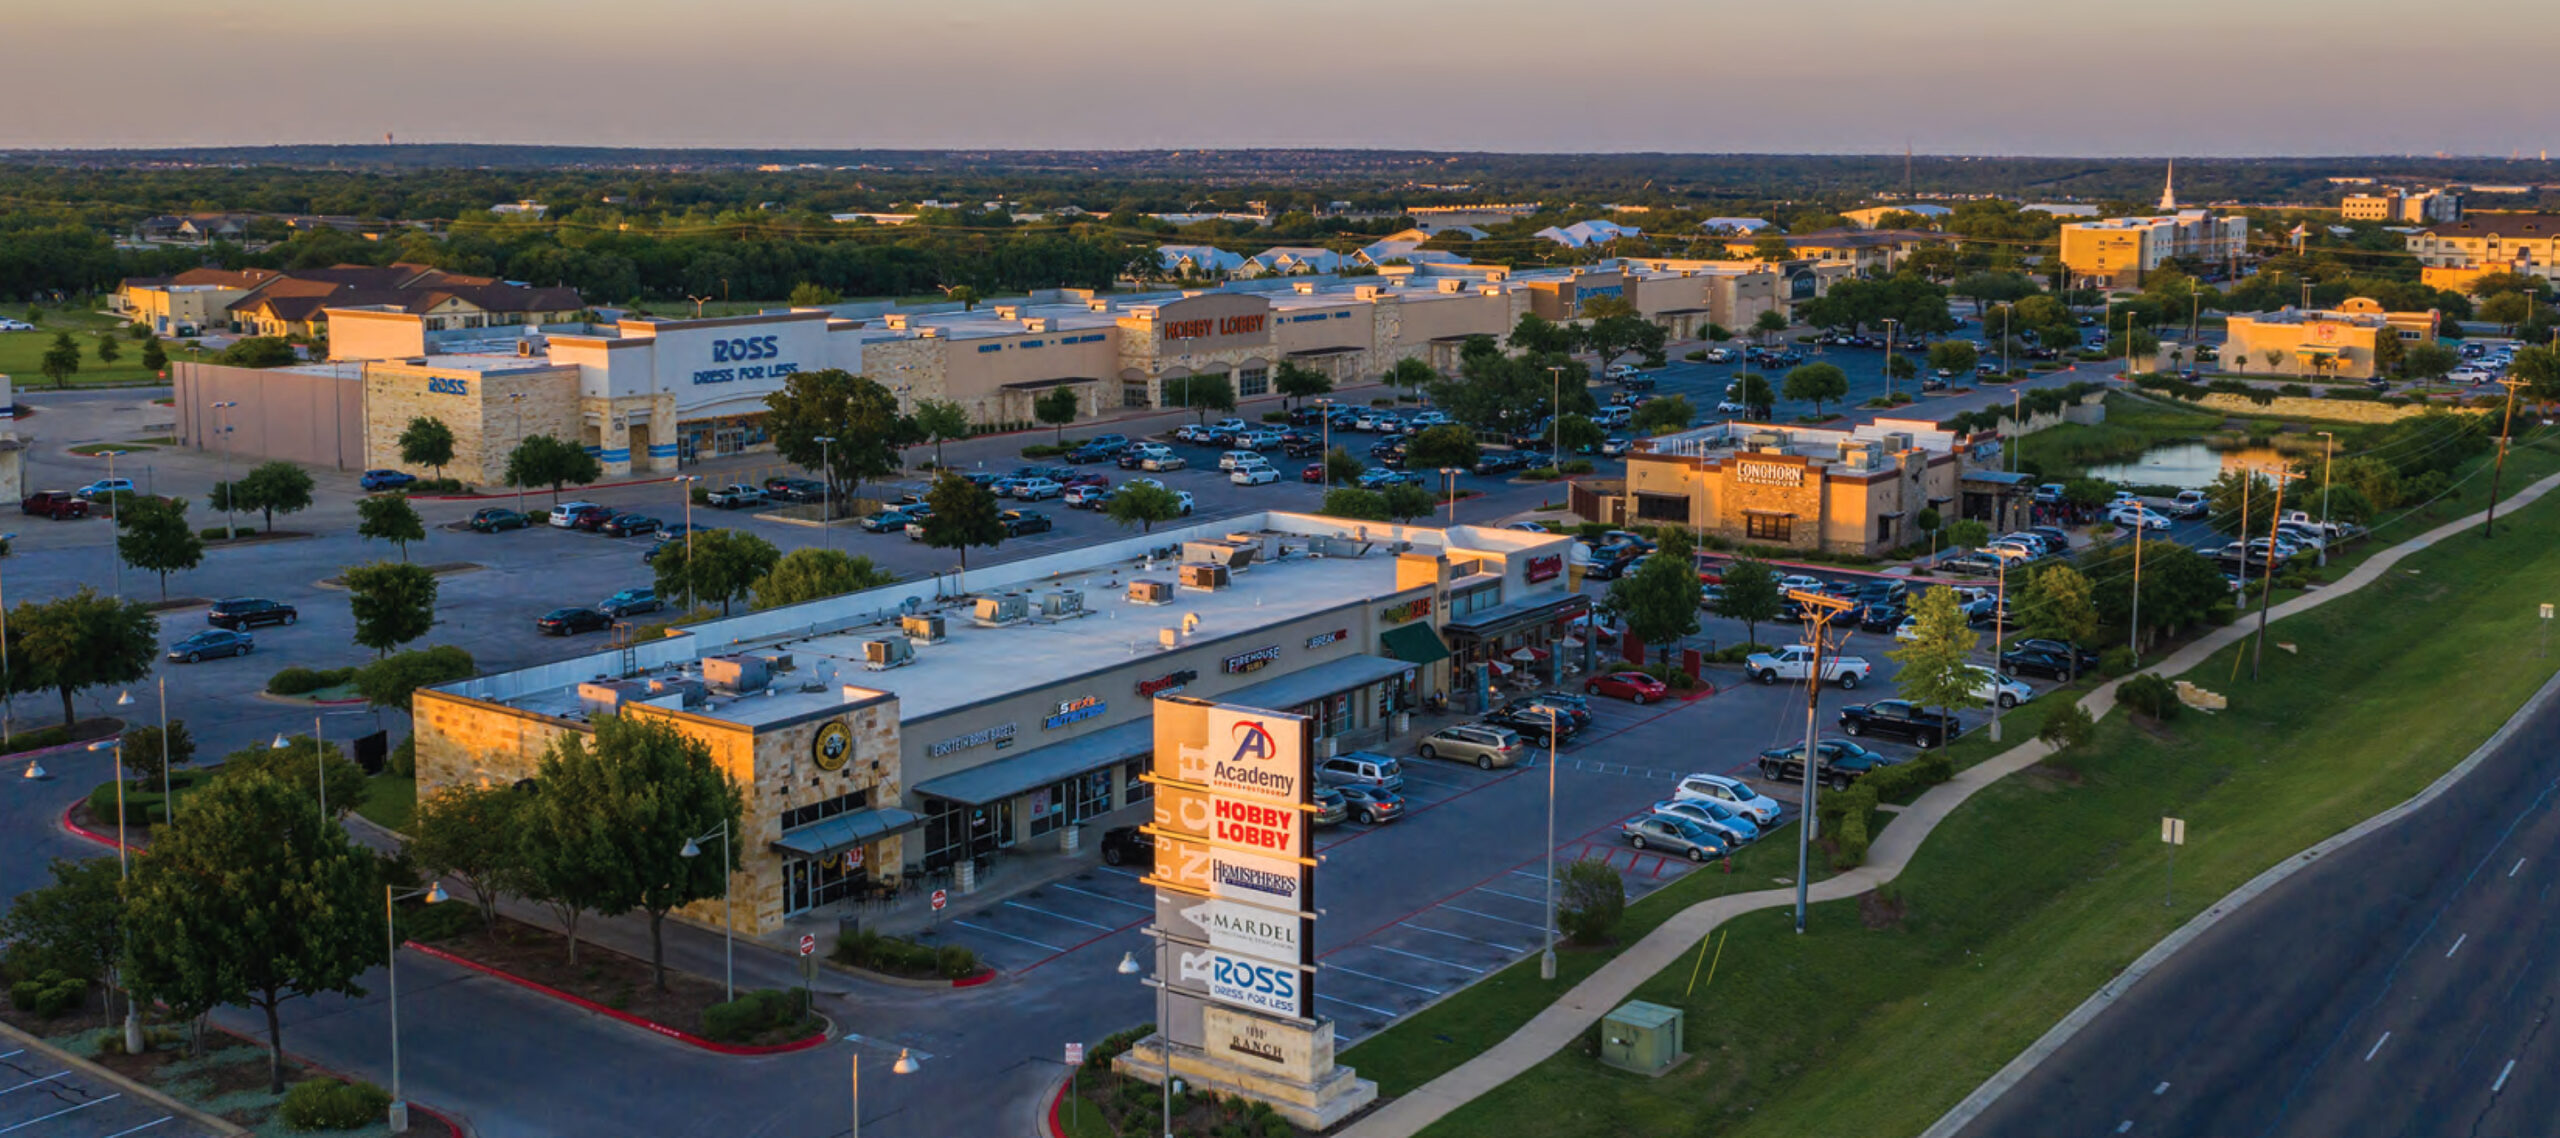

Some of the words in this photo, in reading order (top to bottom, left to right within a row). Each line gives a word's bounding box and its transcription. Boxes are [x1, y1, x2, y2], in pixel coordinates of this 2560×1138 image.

[1165, 319, 1214, 340] HOBBY
[1220, 314, 1265, 336] LOBBY
[713, 335, 778, 363] ROSS
[428, 376, 467, 396] ROSS
[693, 368, 735, 386] DRESS
[738, 365, 765, 381] FOR
[767, 362, 799, 378] LESS
[1737, 461, 1801, 481] LONGHORN
[1228, 646, 1280, 673] FIREHOUSE
[1214, 760, 1294, 797] Academy
[1215, 799, 1292, 830] HOBBY
[1217, 820, 1290, 851] LOBBY
[1179, 741, 1212, 983] RANCH
[1213, 858, 1297, 893] HEMISPHERES
[1214, 914, 1295, 944] MARDEL
[1214, 956, 1294, 999] ROSS
[1214, 985, 1244, 1001] DRESS
[1246, 993, 1267, 1006] FOR
[1269, 998, 1294, 1012] LESS
[1233, 1035, 1282, 1057] RANCH
